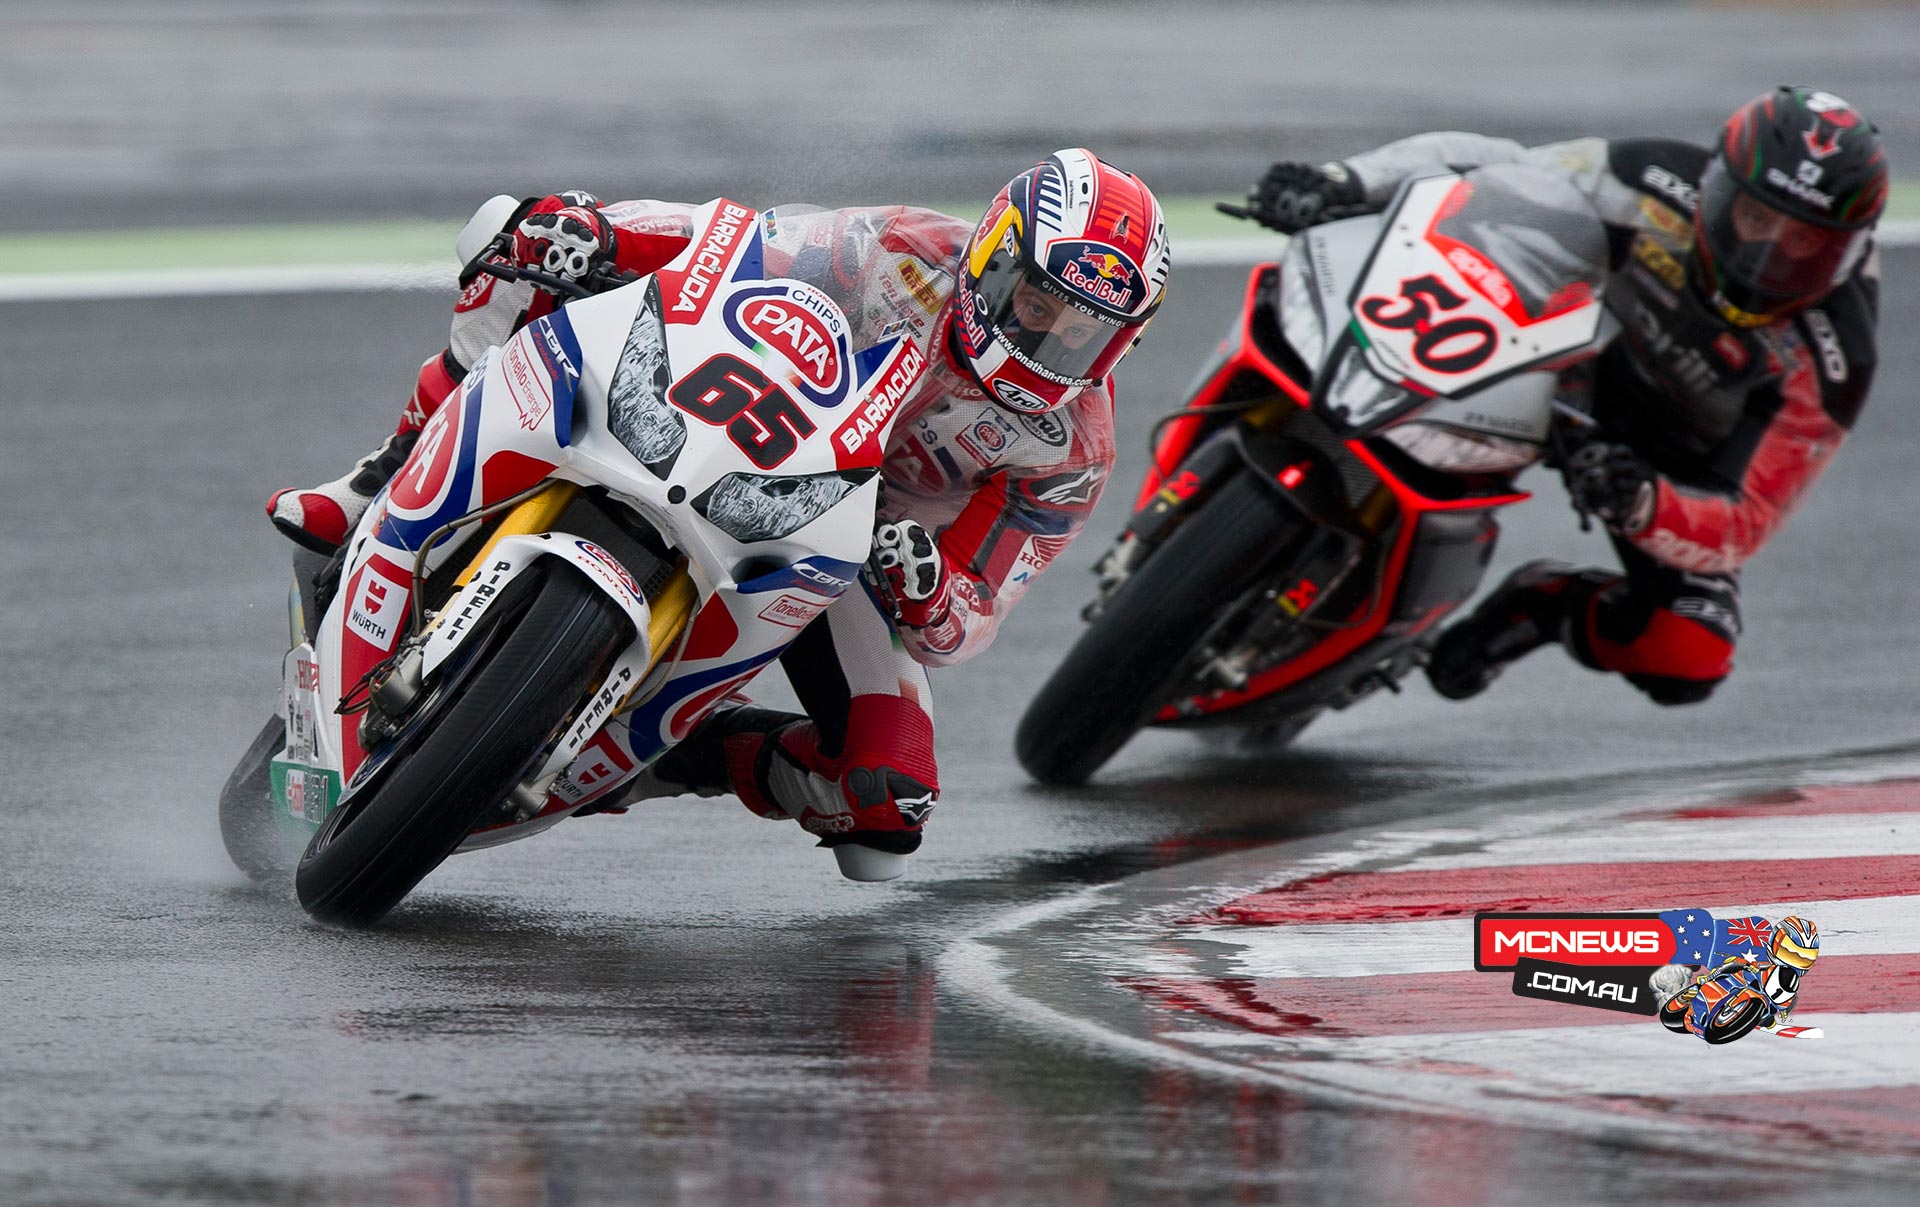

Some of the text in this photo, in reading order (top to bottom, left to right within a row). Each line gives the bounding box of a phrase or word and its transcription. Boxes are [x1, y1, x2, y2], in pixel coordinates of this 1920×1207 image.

[671, 203, 748, 313] BARRACUDA
[752, 304, 831, 380] PATA
[792, 289, 841, 332] CHIPS
[1040, 280, 1127, 329] GIVES YOU WINGS
[1357, 273, 1499, 375] 50
[990, 324, 1093, 388] www.jonathan-rea.com
[668, 353, 818, 471] 65
[840, 349, 924, 454] BARRACUDA
[997, 383, 1046, 410] Arai
[447, 561, 511, 641] PIRELLI
[569, 667, 632, 749] PIRELLI
